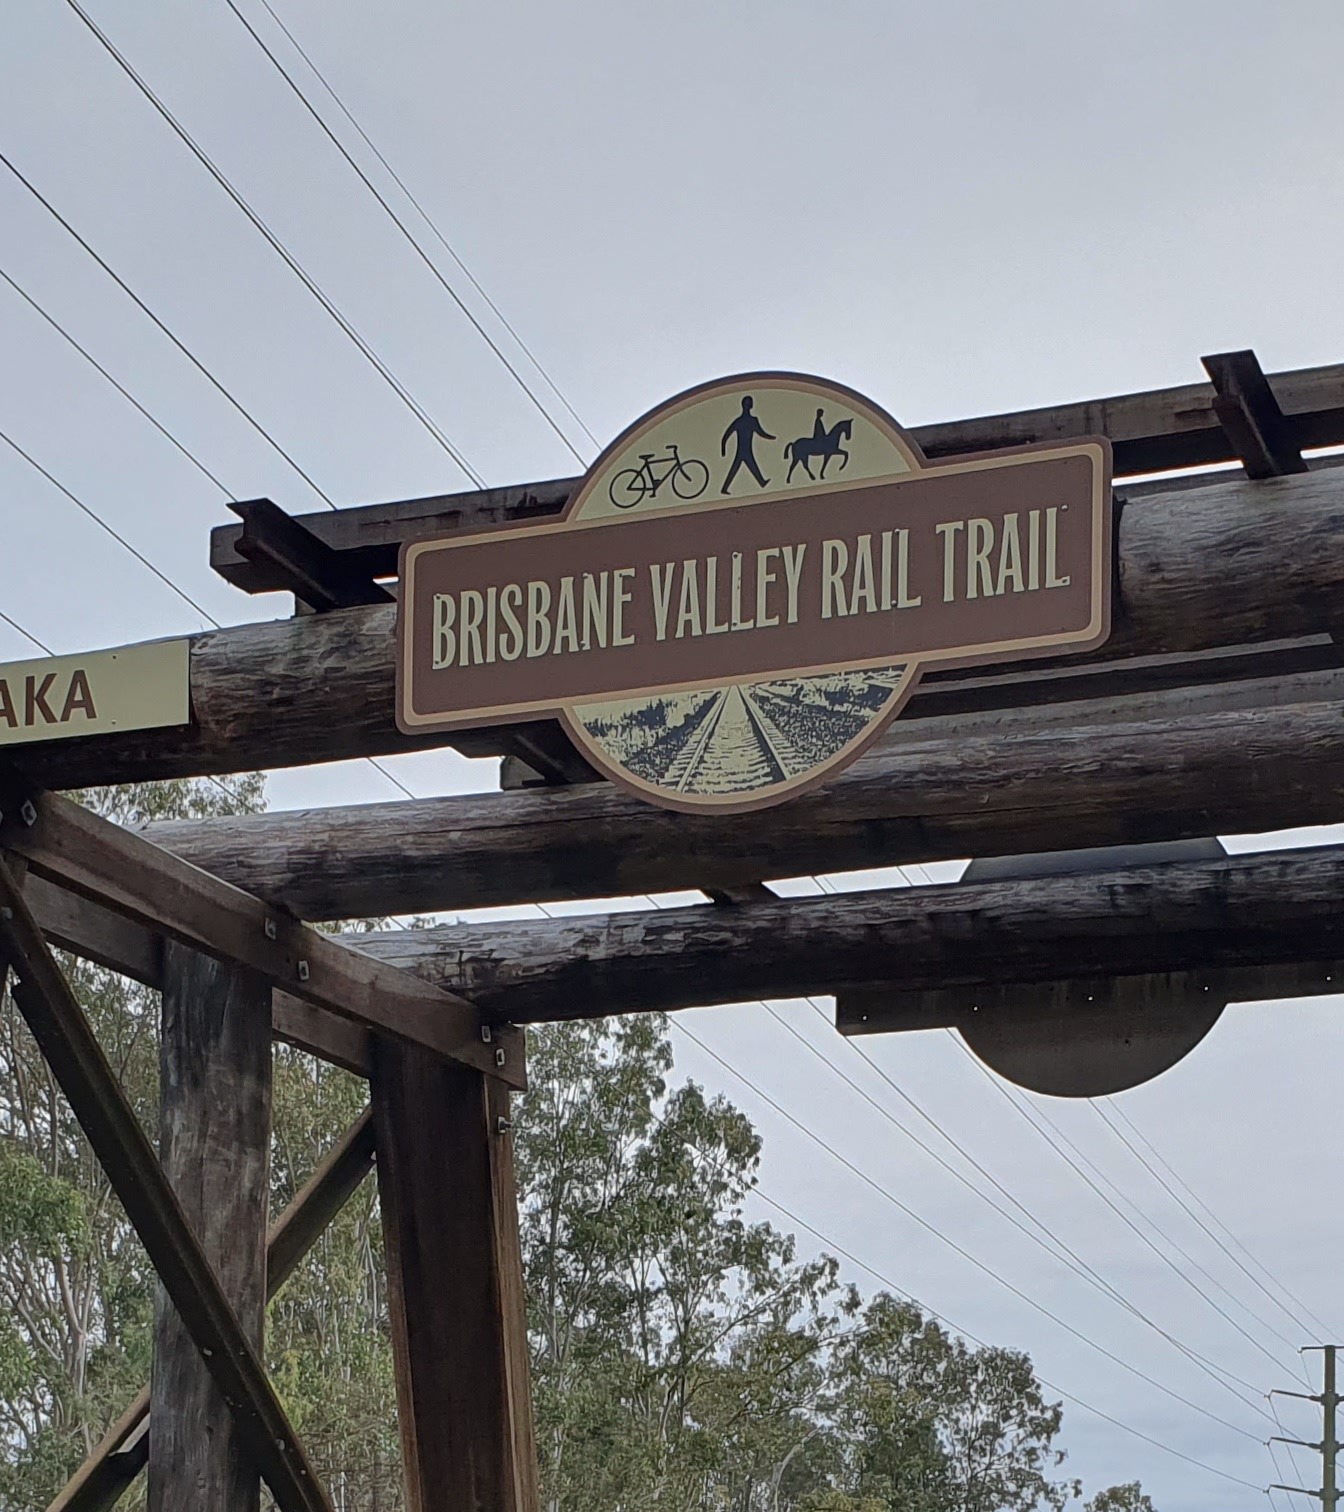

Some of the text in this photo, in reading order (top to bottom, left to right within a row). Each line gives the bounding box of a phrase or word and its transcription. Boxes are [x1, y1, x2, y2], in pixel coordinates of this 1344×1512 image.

[431, 505, 1071, 671] BRISBANE VALLEY RAIL TRAIL
